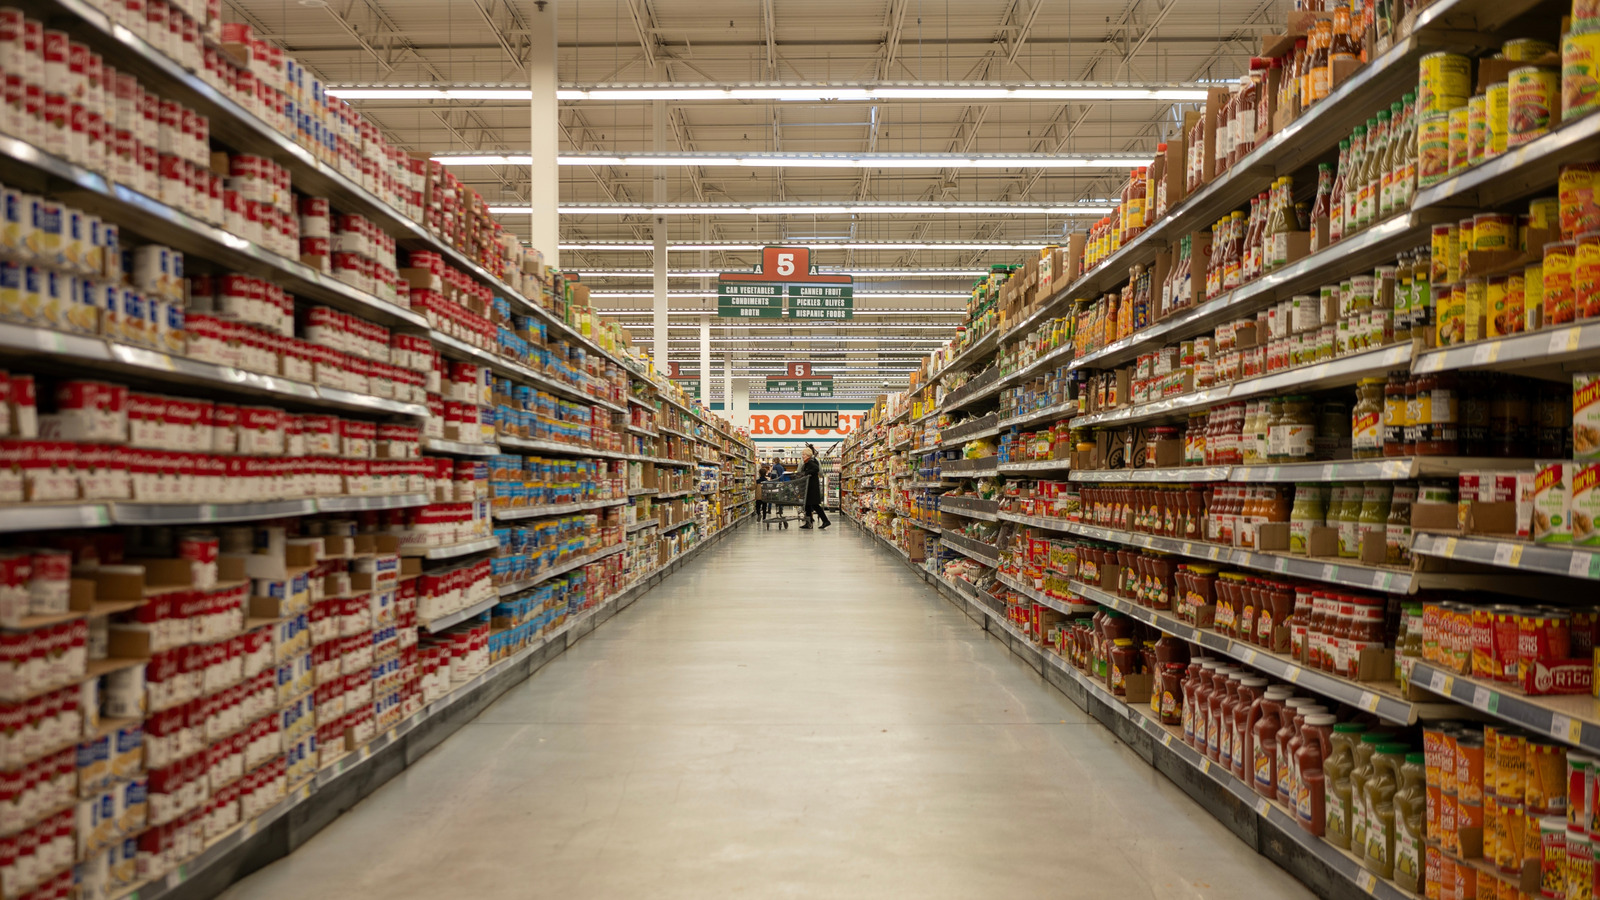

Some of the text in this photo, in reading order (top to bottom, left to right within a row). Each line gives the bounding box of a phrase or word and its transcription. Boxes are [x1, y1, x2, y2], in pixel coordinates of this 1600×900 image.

[753, 264, 763, 274] A
[776, 253, 796, 276] 5
[808, 265, 818, 275] A
[725, 286, 775, 295] CAN VEGETABLES
[800, 287, 842, 296] CANNED FRUIT
[731, 297, 770, 305] CONDIMENTS
[740, 308, 760, 316] BROTH
[795, 309, 846, 318] HISPANIC FOODS
[794, 364, 805, 377] 5
[804, 412, 838, 427] WINE
